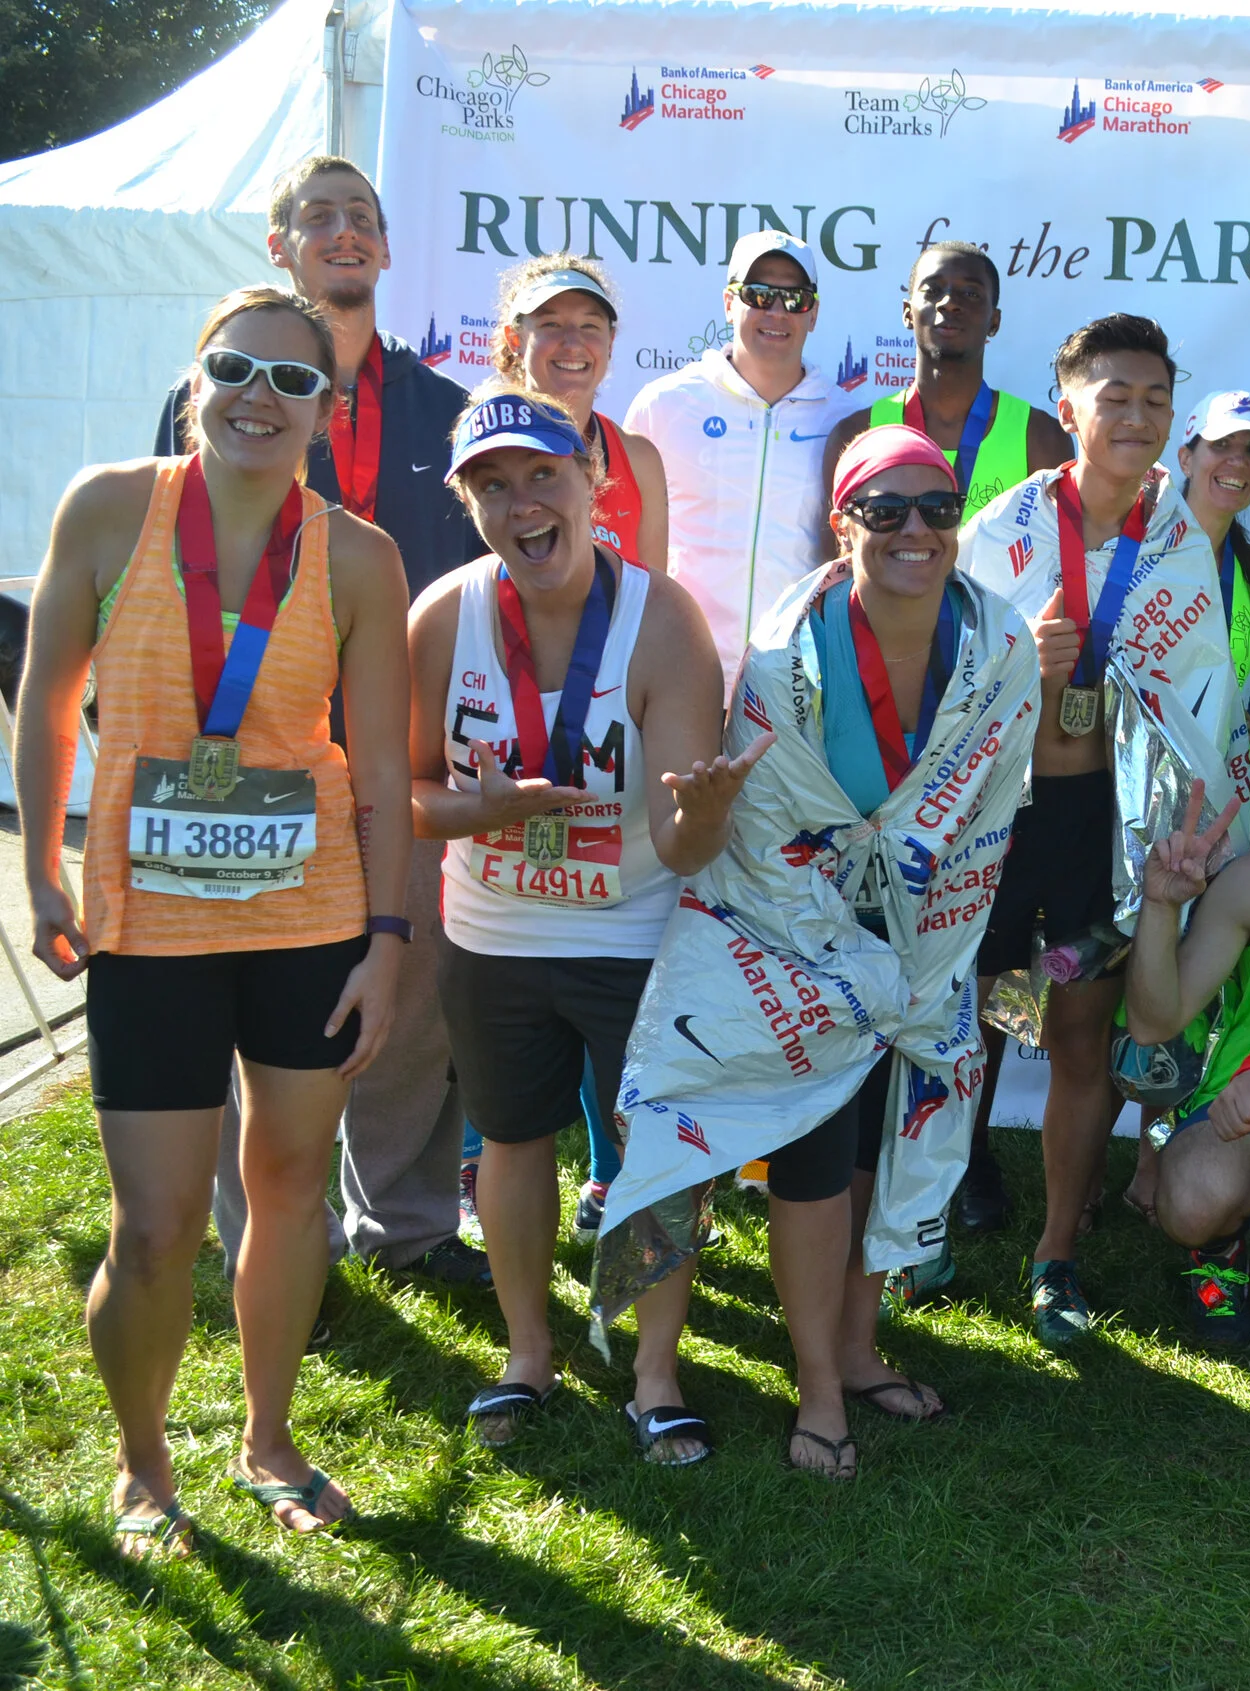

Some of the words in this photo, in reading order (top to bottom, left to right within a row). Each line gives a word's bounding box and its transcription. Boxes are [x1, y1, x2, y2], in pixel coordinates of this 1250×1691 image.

[661, 66, 688, 78] Bank
[689, 67, 701, 79] of
[701, 67, 746, 80] America
[416, 75, 503, 113] Chicago
[661, 84, 727, 104] Chicago
[1104, 79, 1133, 91] Bank
[1135, 80, 1146, 92] of
[1147, 80, 1193, 93] America
[845, 91, 900, 112] Team
[1104, 96, 1172, 117] Chicago
[462, 107, 514, 128] Parks
[661, 104, 745, 120] Marathon
[441, 125, 515, 142] FOUNDATION
[844, 114, 932, 136] ChiParks
[1103, 116, 1189, 134] Marathon
[456, 191, 881, 272] RUNNING
[1007, 221, 1090, 279] the
[461, 315, 489, 327] Bank
[876, 335, 902, 347] Bank
[875, 352, 917, 368] Chica
[875, 371, 915, 388] Mara
[471, 404, 532, 438] CUBS
[462, 671, 486, 690] CHI
[914, 720, 1003, 829] Chicago
[565, 802, 623, 818] SPORTS
[145, 817, 170, 856] H
[185, 822, 303, 859] 38847
[144, 861, 172, 872] Gate
[216, 870, 262, 880] October
[513, 860, 610, 899] 14914
[726, 935, 813, 1078] Marathon
